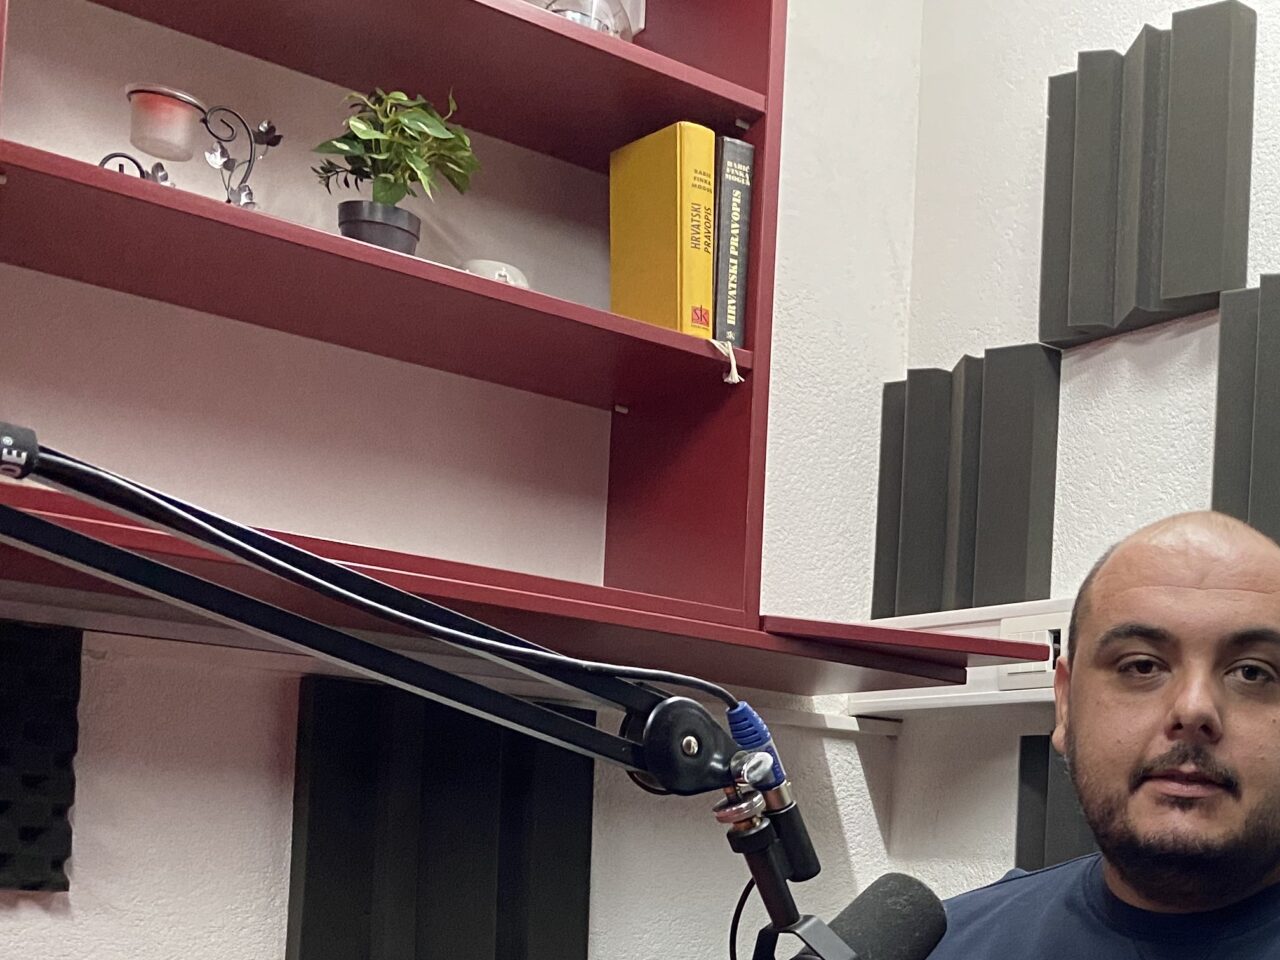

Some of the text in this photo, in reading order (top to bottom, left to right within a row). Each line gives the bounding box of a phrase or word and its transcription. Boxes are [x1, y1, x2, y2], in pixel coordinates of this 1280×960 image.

[690, 202, 701, 250] HRVATSKI
[703, 206, 712, 255] PRAVOPIS
[730, 189, 741, 256] PRAVOPIS
[727, 258, 738, 325] HRVATSKI
